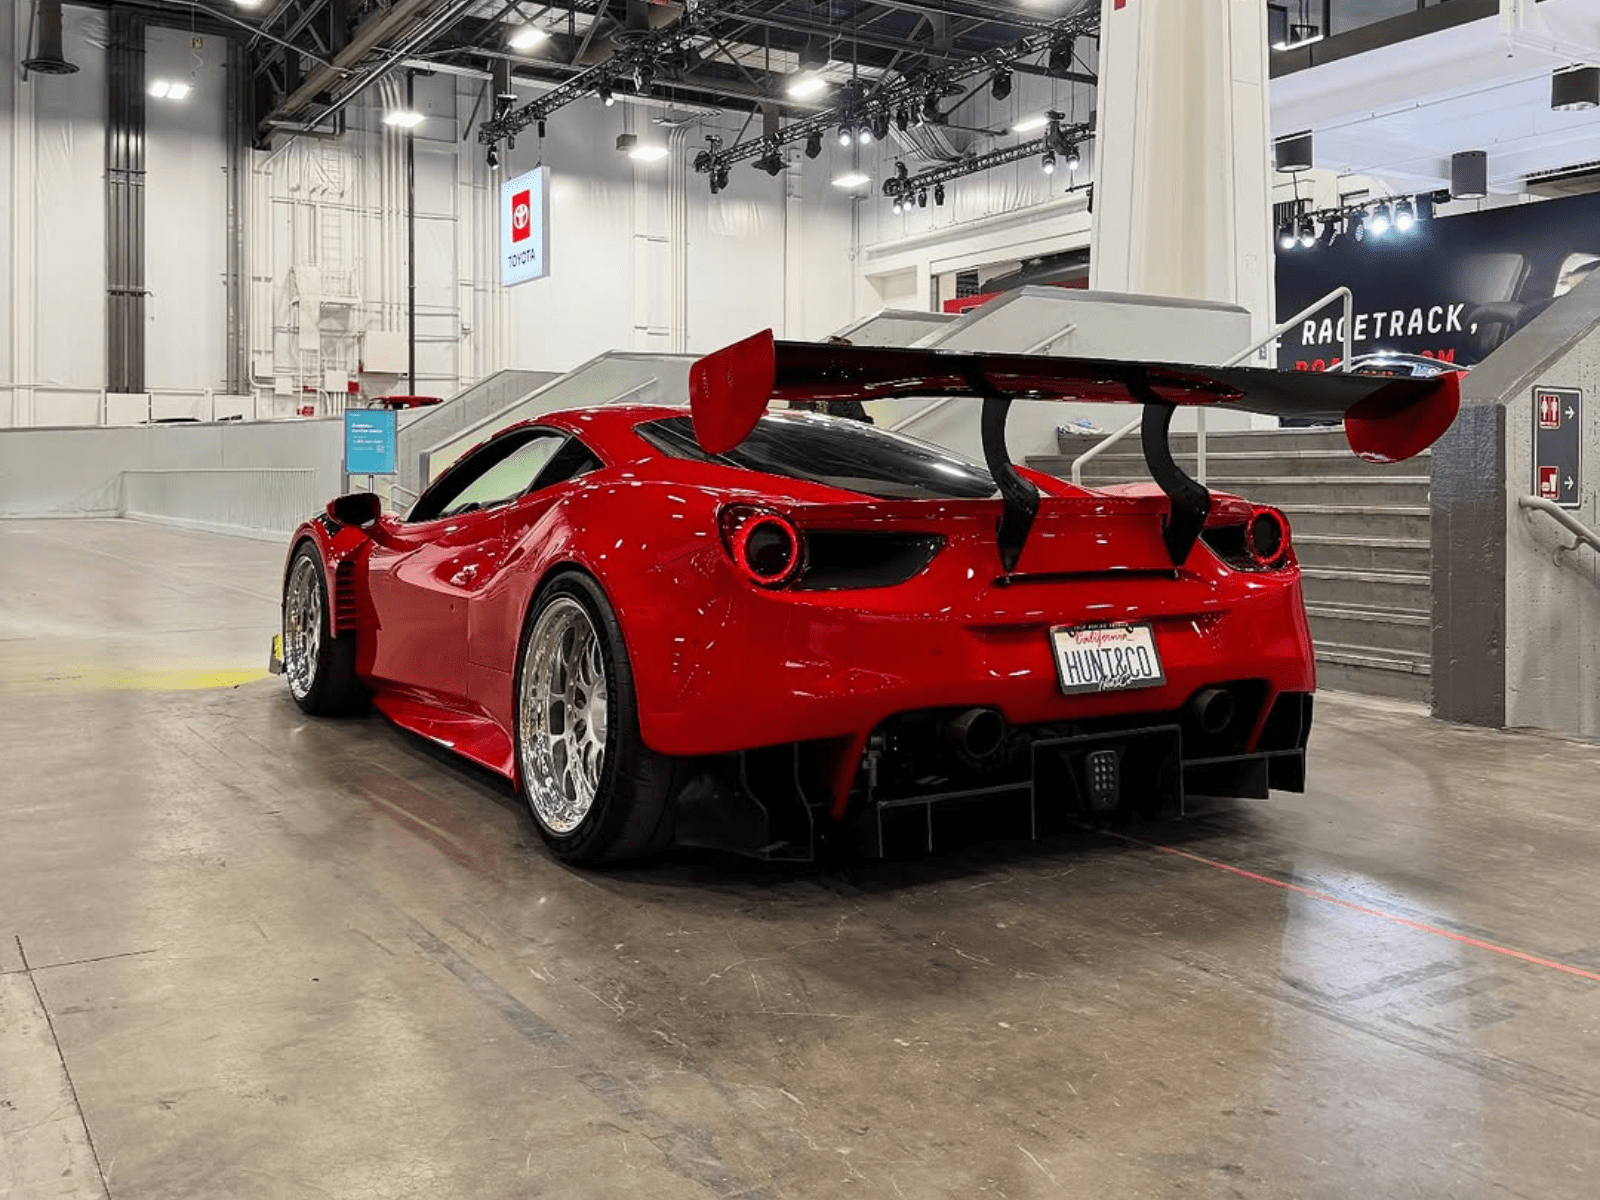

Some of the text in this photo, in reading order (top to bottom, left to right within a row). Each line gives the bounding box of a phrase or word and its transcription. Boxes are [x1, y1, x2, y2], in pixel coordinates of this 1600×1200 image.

[508, 248, 535, 268] TOYOTA
[1074, 631, 1129, 648] California
[1064, 646, 1152, 683] HUNT&CO
